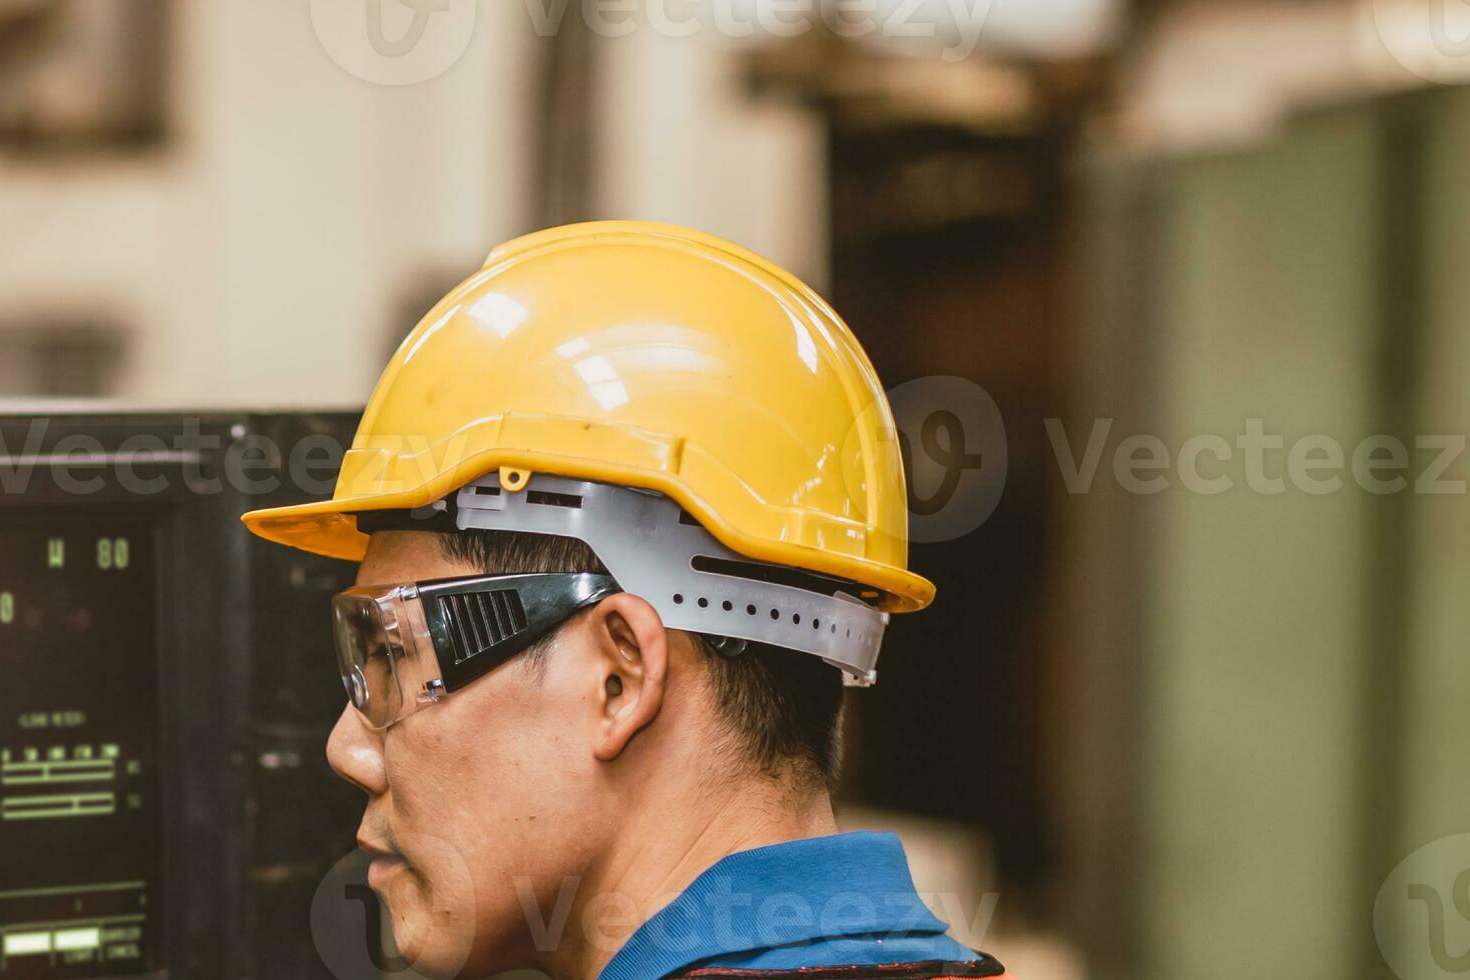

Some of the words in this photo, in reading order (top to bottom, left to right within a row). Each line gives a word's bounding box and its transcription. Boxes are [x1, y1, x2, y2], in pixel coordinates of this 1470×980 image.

[48, 540, 64, 568] W
[98, 538, 128, 569] 80
[0, 592, 14, 623] 0
